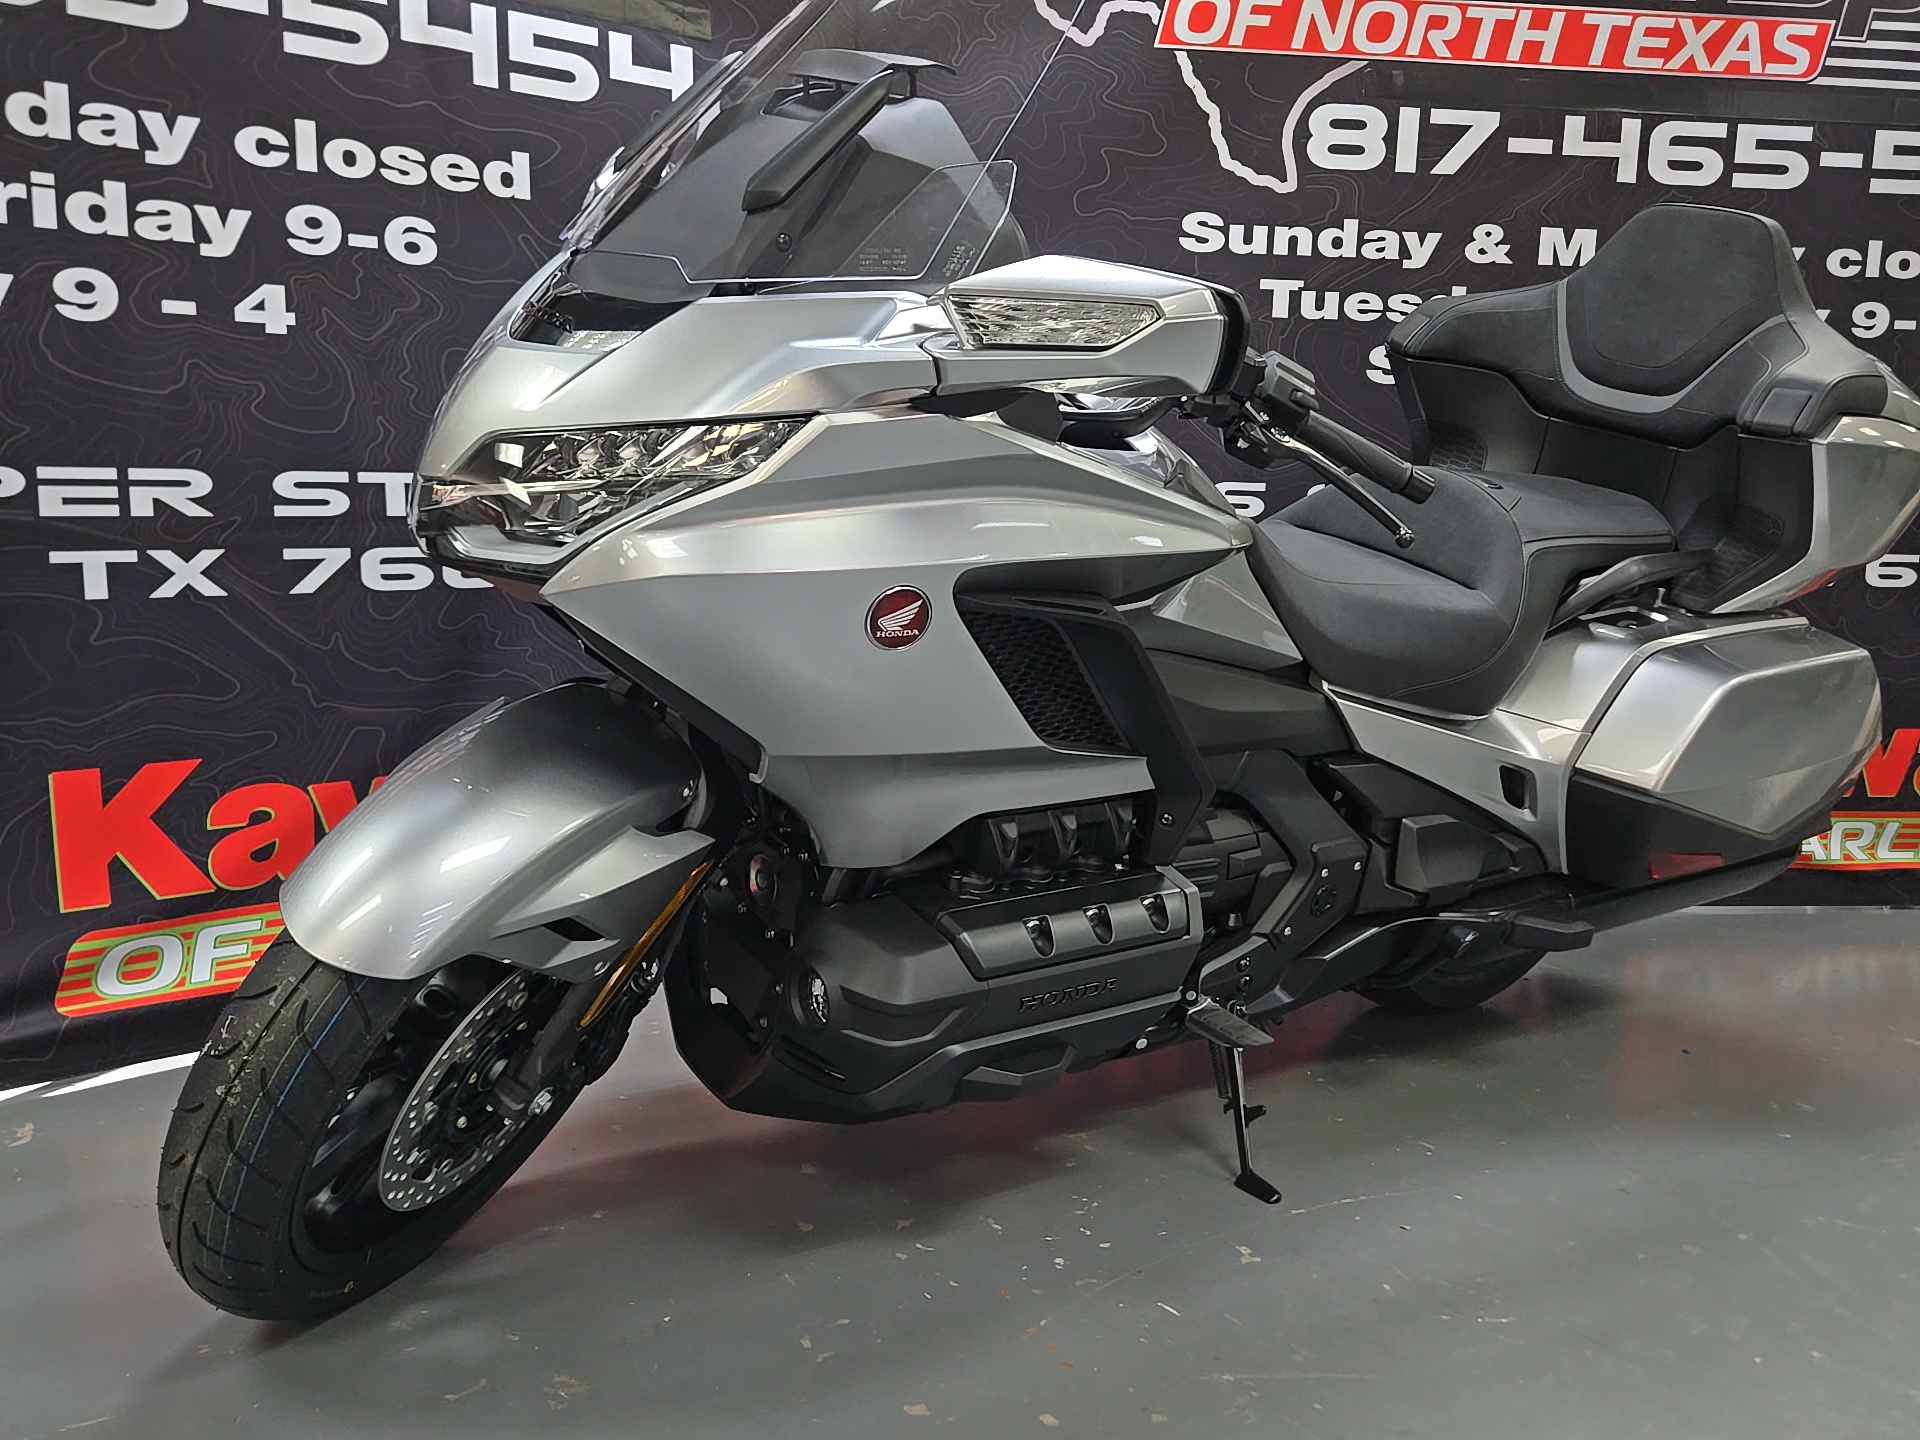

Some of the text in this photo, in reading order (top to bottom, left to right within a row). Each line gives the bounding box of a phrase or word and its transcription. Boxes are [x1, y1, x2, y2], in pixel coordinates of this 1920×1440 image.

[1173, 0, 1282, 46] OF
[1291, 0, 1567, 64] NORTH
[1582, 12, 1818, 76] TEXAS
[234, 118, 531, 200] closed
[284, 204, 439, 266] 9-6
[1178, 211, 1443, 269] Sunday
[1464, 223, 1514, 266] &
[52, 266, 119, 322] 9
[234, 283, 297, 335] 4
[49, 549, 229, 600] TX
[875, 629, 920, 638] HONDA
[96, 918, 263, 996] OF
[1018, 977, 1118, 1013] HONDA
